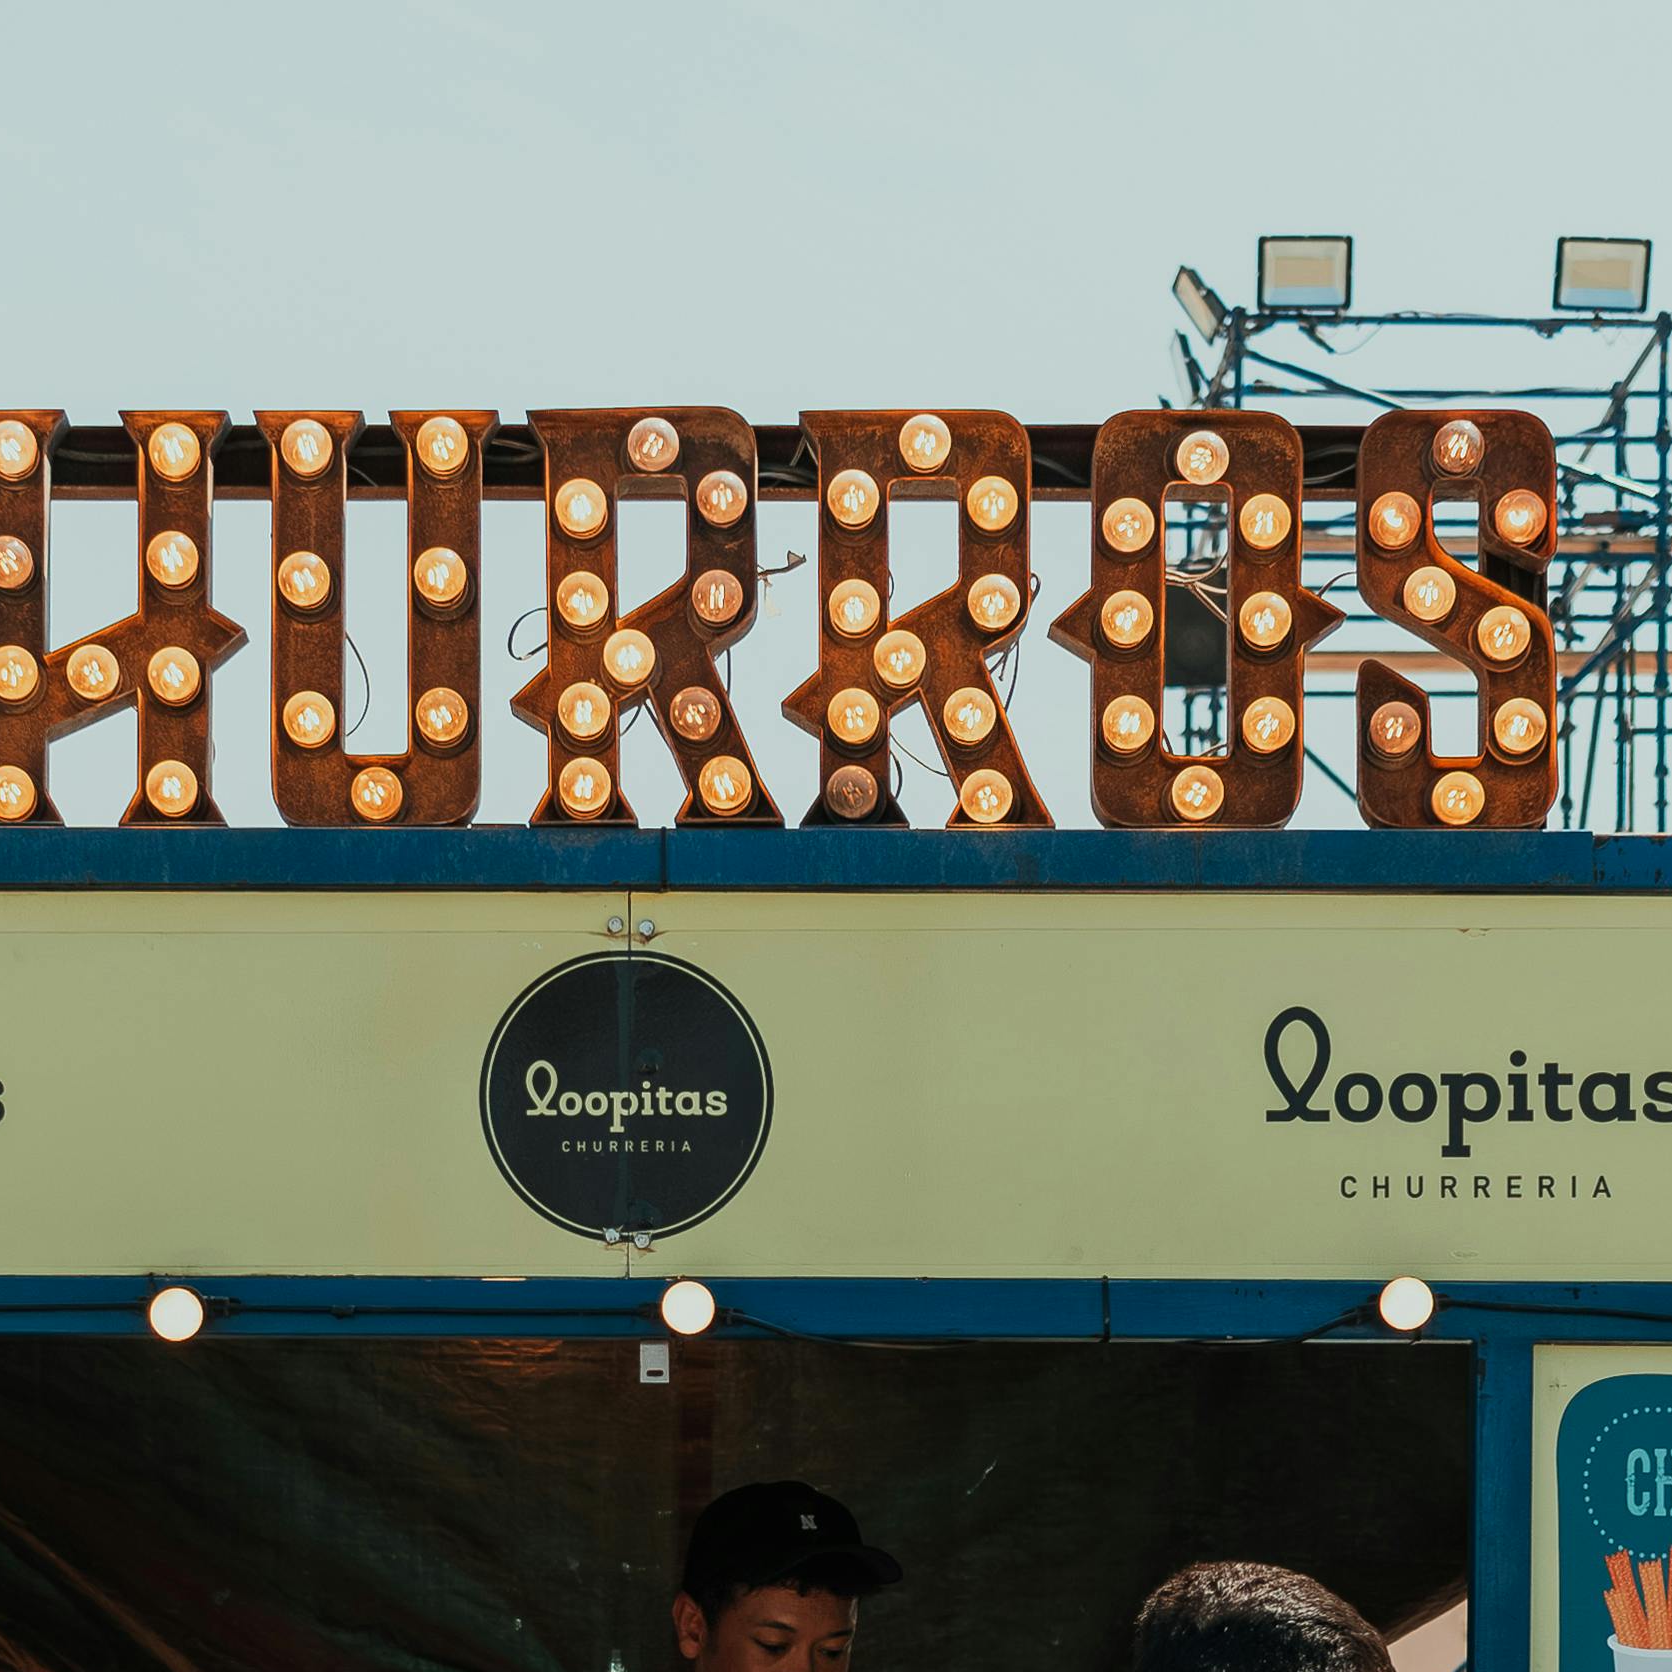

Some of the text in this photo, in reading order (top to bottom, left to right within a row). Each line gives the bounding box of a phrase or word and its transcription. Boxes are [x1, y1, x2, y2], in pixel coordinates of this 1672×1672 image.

[526, 1060, 727, 1132] loopitas
[562, 1141, 690, 1152] CHURRERIA
[1341, 1176, 1611, 1198] CHURRERIA
